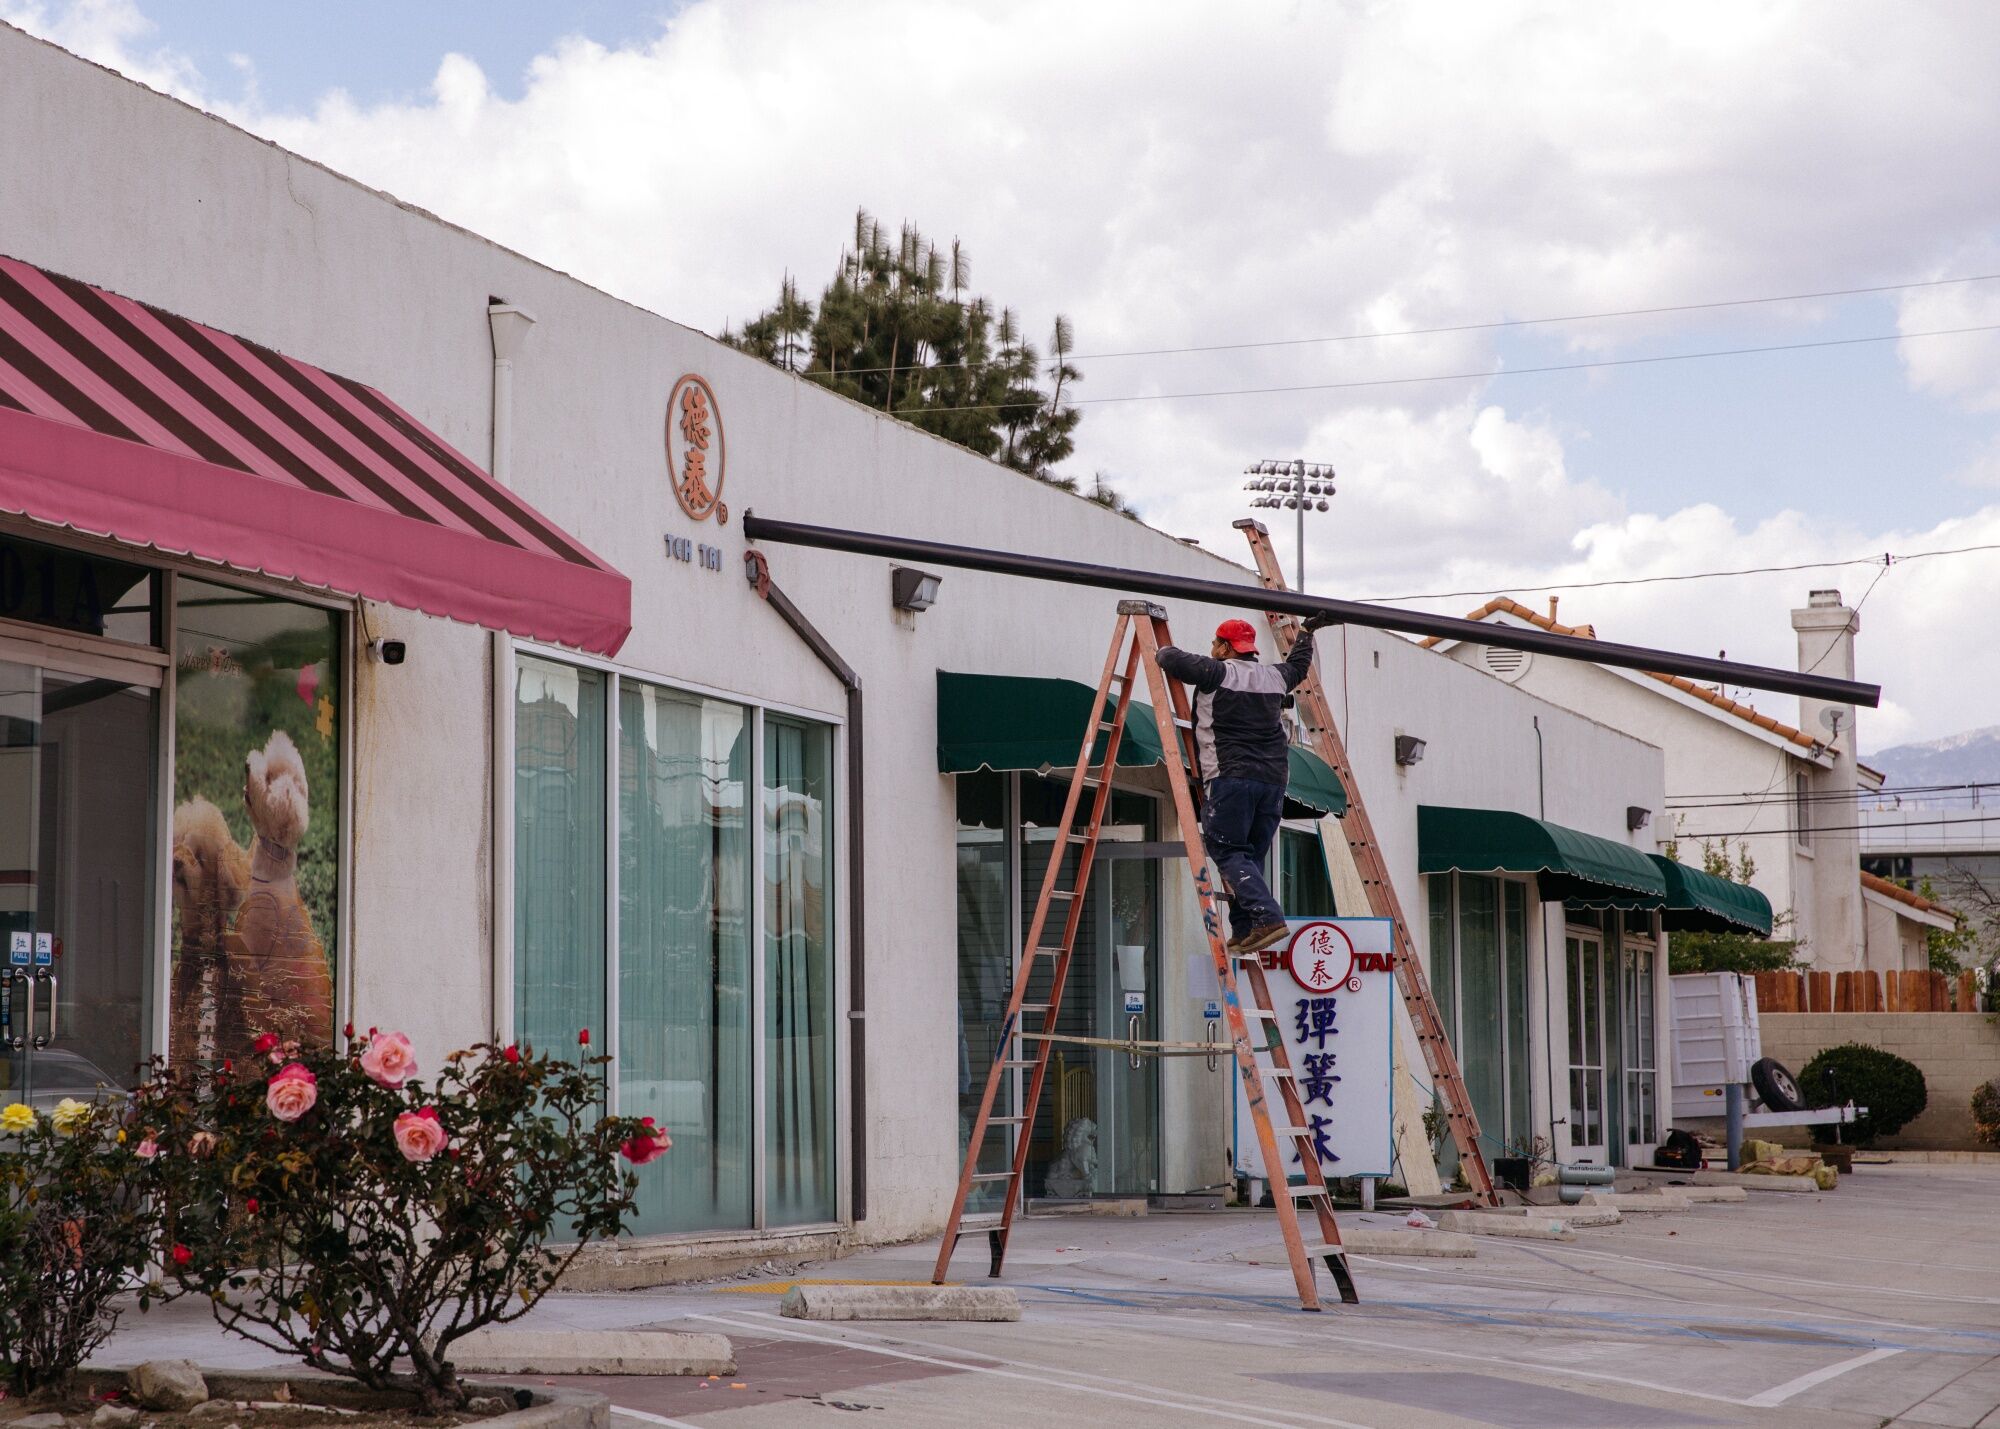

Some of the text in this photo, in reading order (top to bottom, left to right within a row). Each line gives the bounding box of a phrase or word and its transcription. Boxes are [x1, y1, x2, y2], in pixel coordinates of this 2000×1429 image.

[698, 544, 723, 572] TAI
[13, 952, 28, 960] PULL
[36, 952, 49, 960] PULL
[1309, 930, 1334, 985] 德泰
[1354, 952, 1393, 972] TAI
